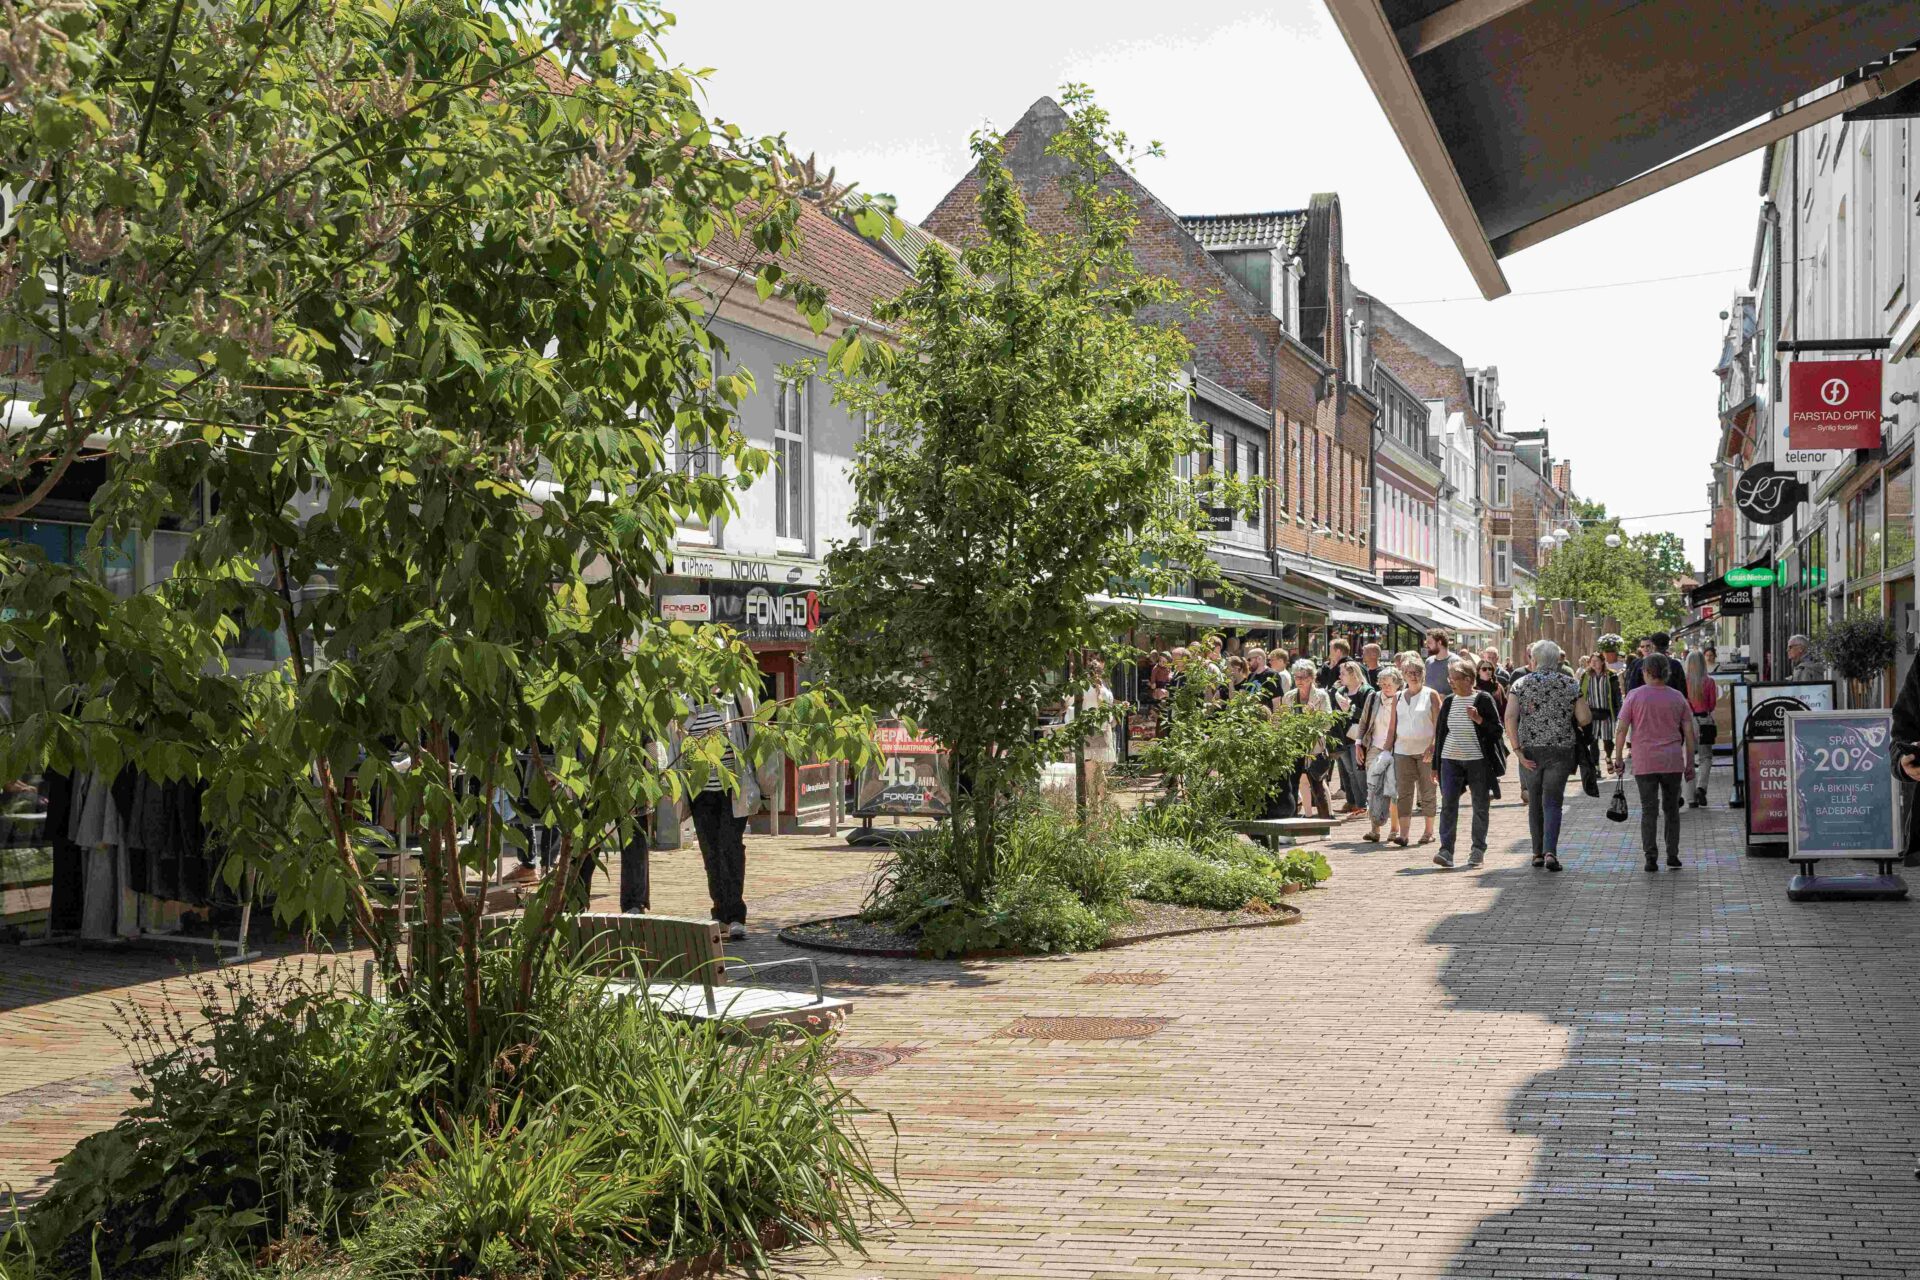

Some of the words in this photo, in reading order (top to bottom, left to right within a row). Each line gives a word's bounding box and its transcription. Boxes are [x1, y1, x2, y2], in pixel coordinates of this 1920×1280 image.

[1793, 411, 1841, 421] FARSTAD
[1843, 410, 1876, 420] OPTIK
[1785, 450, 1827, 463] telenor
[687, 557, 714, 577] iPhone
[730, 560, 769, 582] NOKIA
[1727, 573, 1747, 581] Louis
[1747, 573, 1773, 581] Nielsen
[1829, 735, 1856, 746] SPAR
[1814, 748, 1873, 772] 20%
[879, 757, 916, 787] 45
[918, 776, 938, 787] MIN.
[1813, 782, 1825, 793] PÅ
[1831, 795, 1857, 804] ELLER
[1815, 806, 1873, 815] BADEDRAGT
